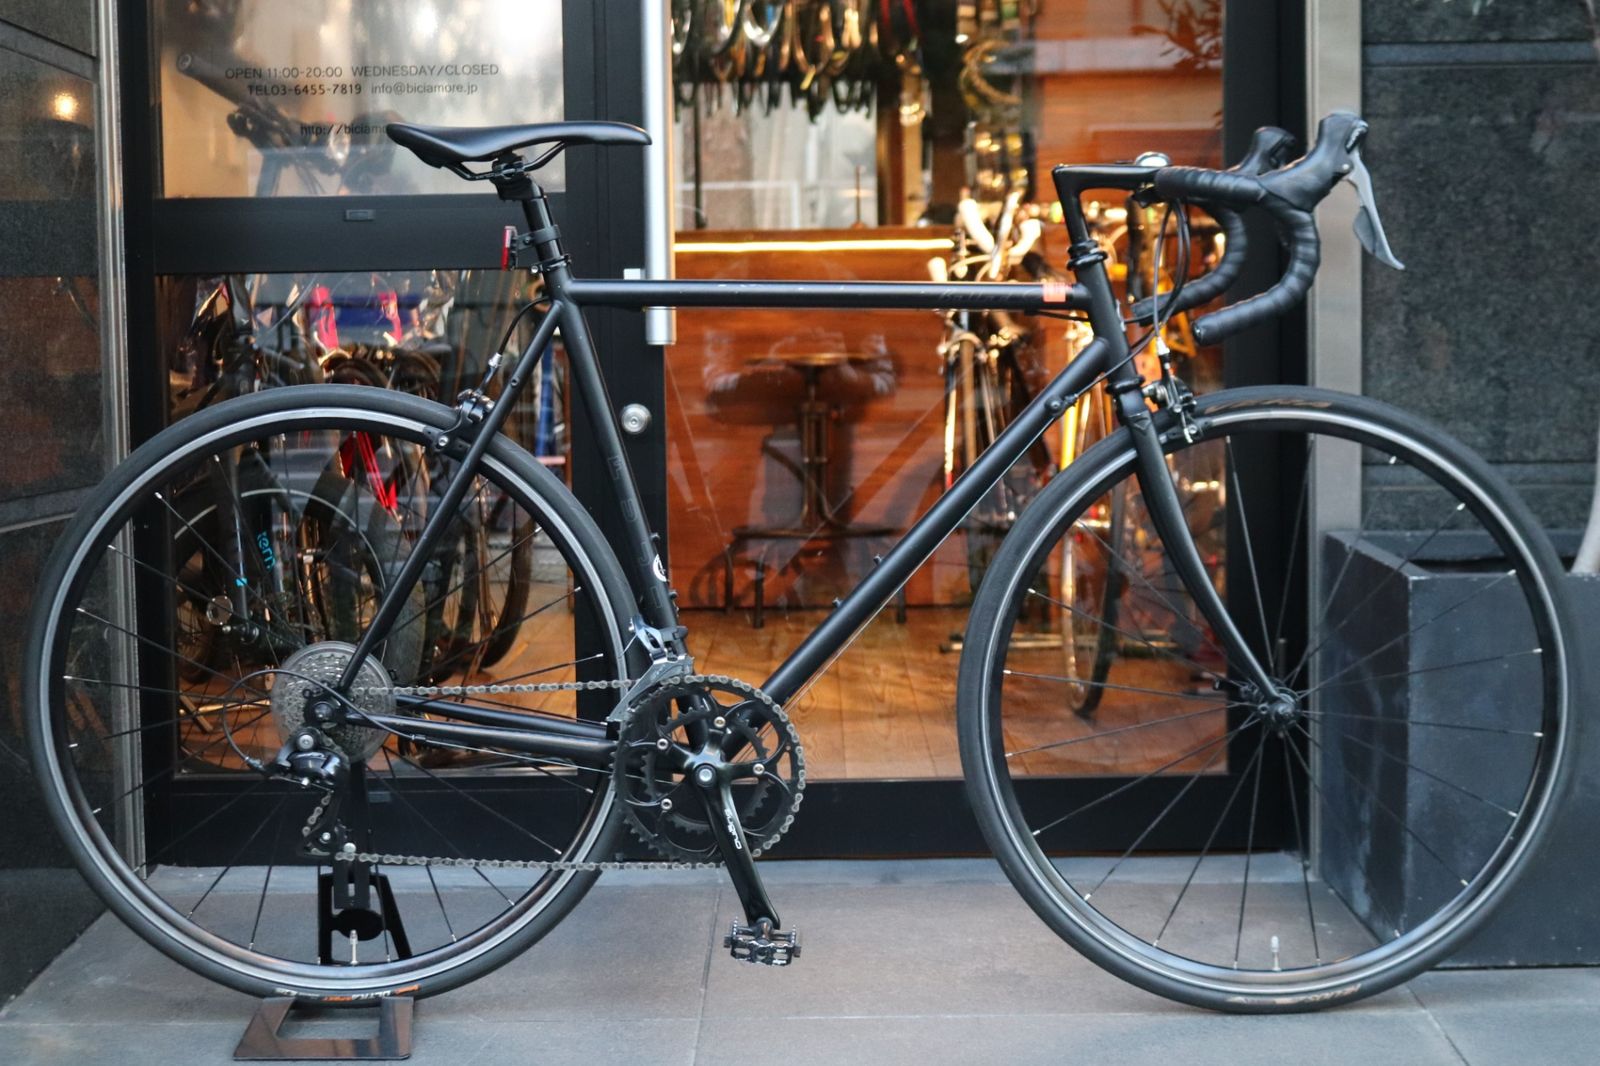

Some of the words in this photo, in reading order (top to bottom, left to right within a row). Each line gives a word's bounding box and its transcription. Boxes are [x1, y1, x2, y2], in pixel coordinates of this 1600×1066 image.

[225, 67, 262, 79] OPEN
[267, 66, 343, 79] 11:00-20:00
[351, 64, 499, 77] WEDNESDAY/CLOSED
[247, 83, 362, 96] TEL03-6455-7819
[371, 82, 478, 95] info@biciamore.jp
